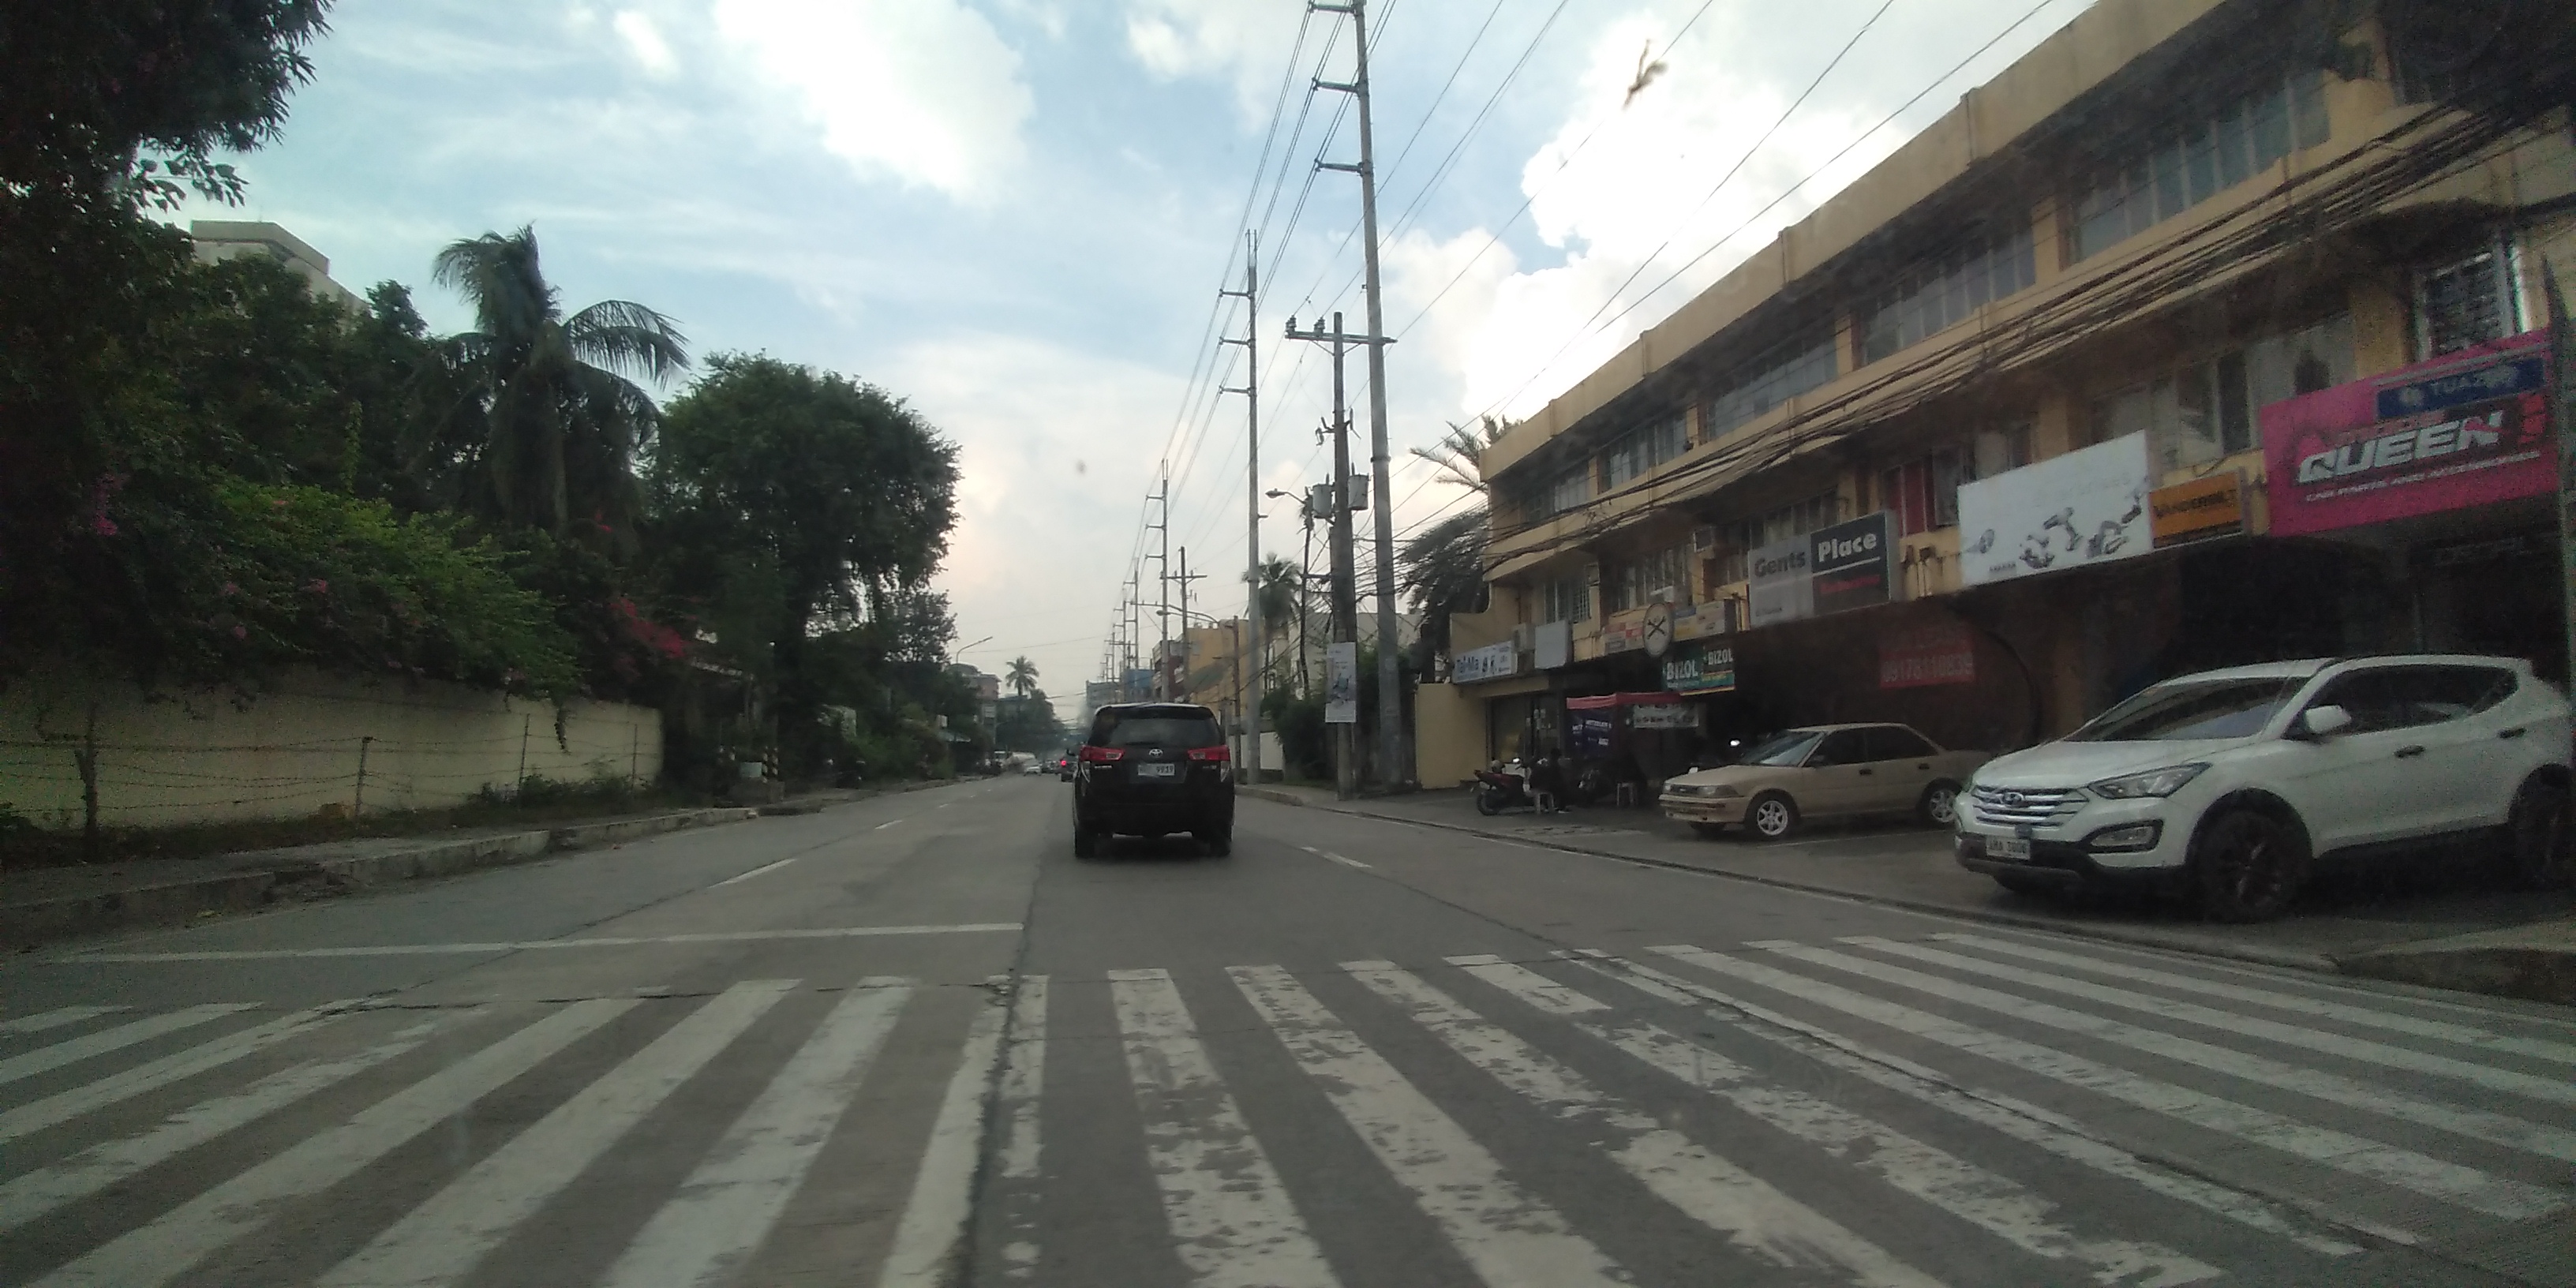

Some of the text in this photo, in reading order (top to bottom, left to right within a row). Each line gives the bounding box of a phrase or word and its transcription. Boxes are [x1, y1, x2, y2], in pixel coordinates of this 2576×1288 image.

[2298, 410, 2504, 483] QUEEN
[2336, 479, 2388, 496] PARTS
[2391, 472, 2424, 486] AND
[1754, 532, 1878, 578] Gents Place
[1708, 647, 1734, 665] BIZOL
[1665, 660, 1698, 681] BIZOL
